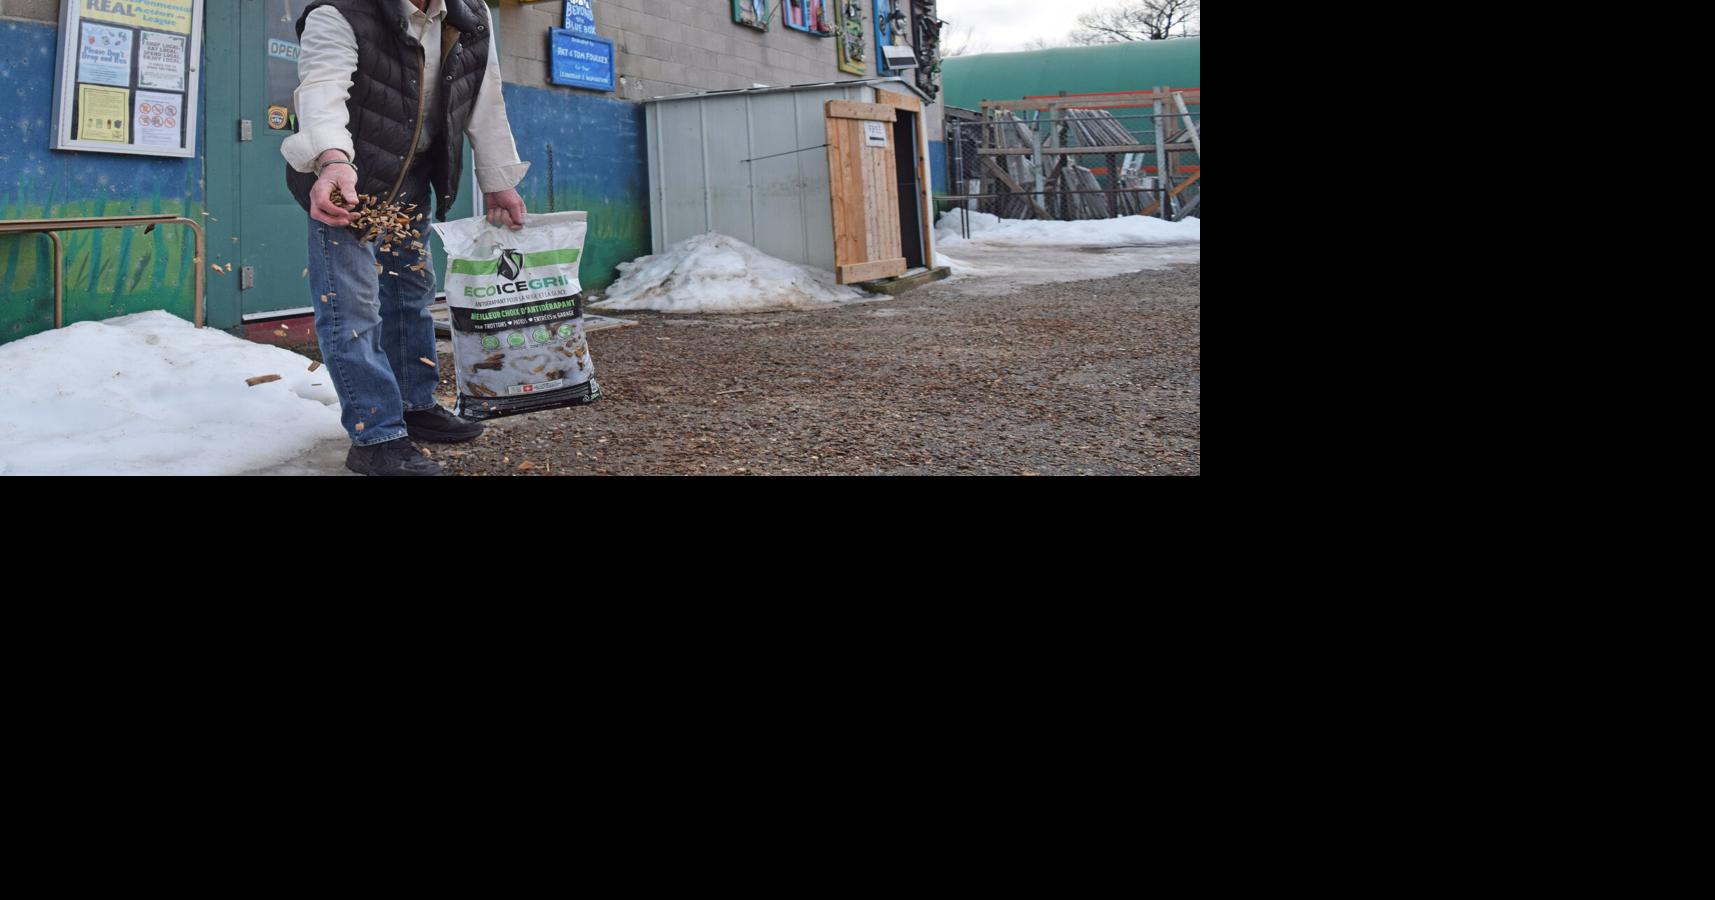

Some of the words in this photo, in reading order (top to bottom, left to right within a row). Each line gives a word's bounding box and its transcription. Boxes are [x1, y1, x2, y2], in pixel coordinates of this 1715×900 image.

[86, 0, 136, 17] REAL
[270, 42, 300, 59] OPEN
[501, 308, 520, 318] CHOIX
